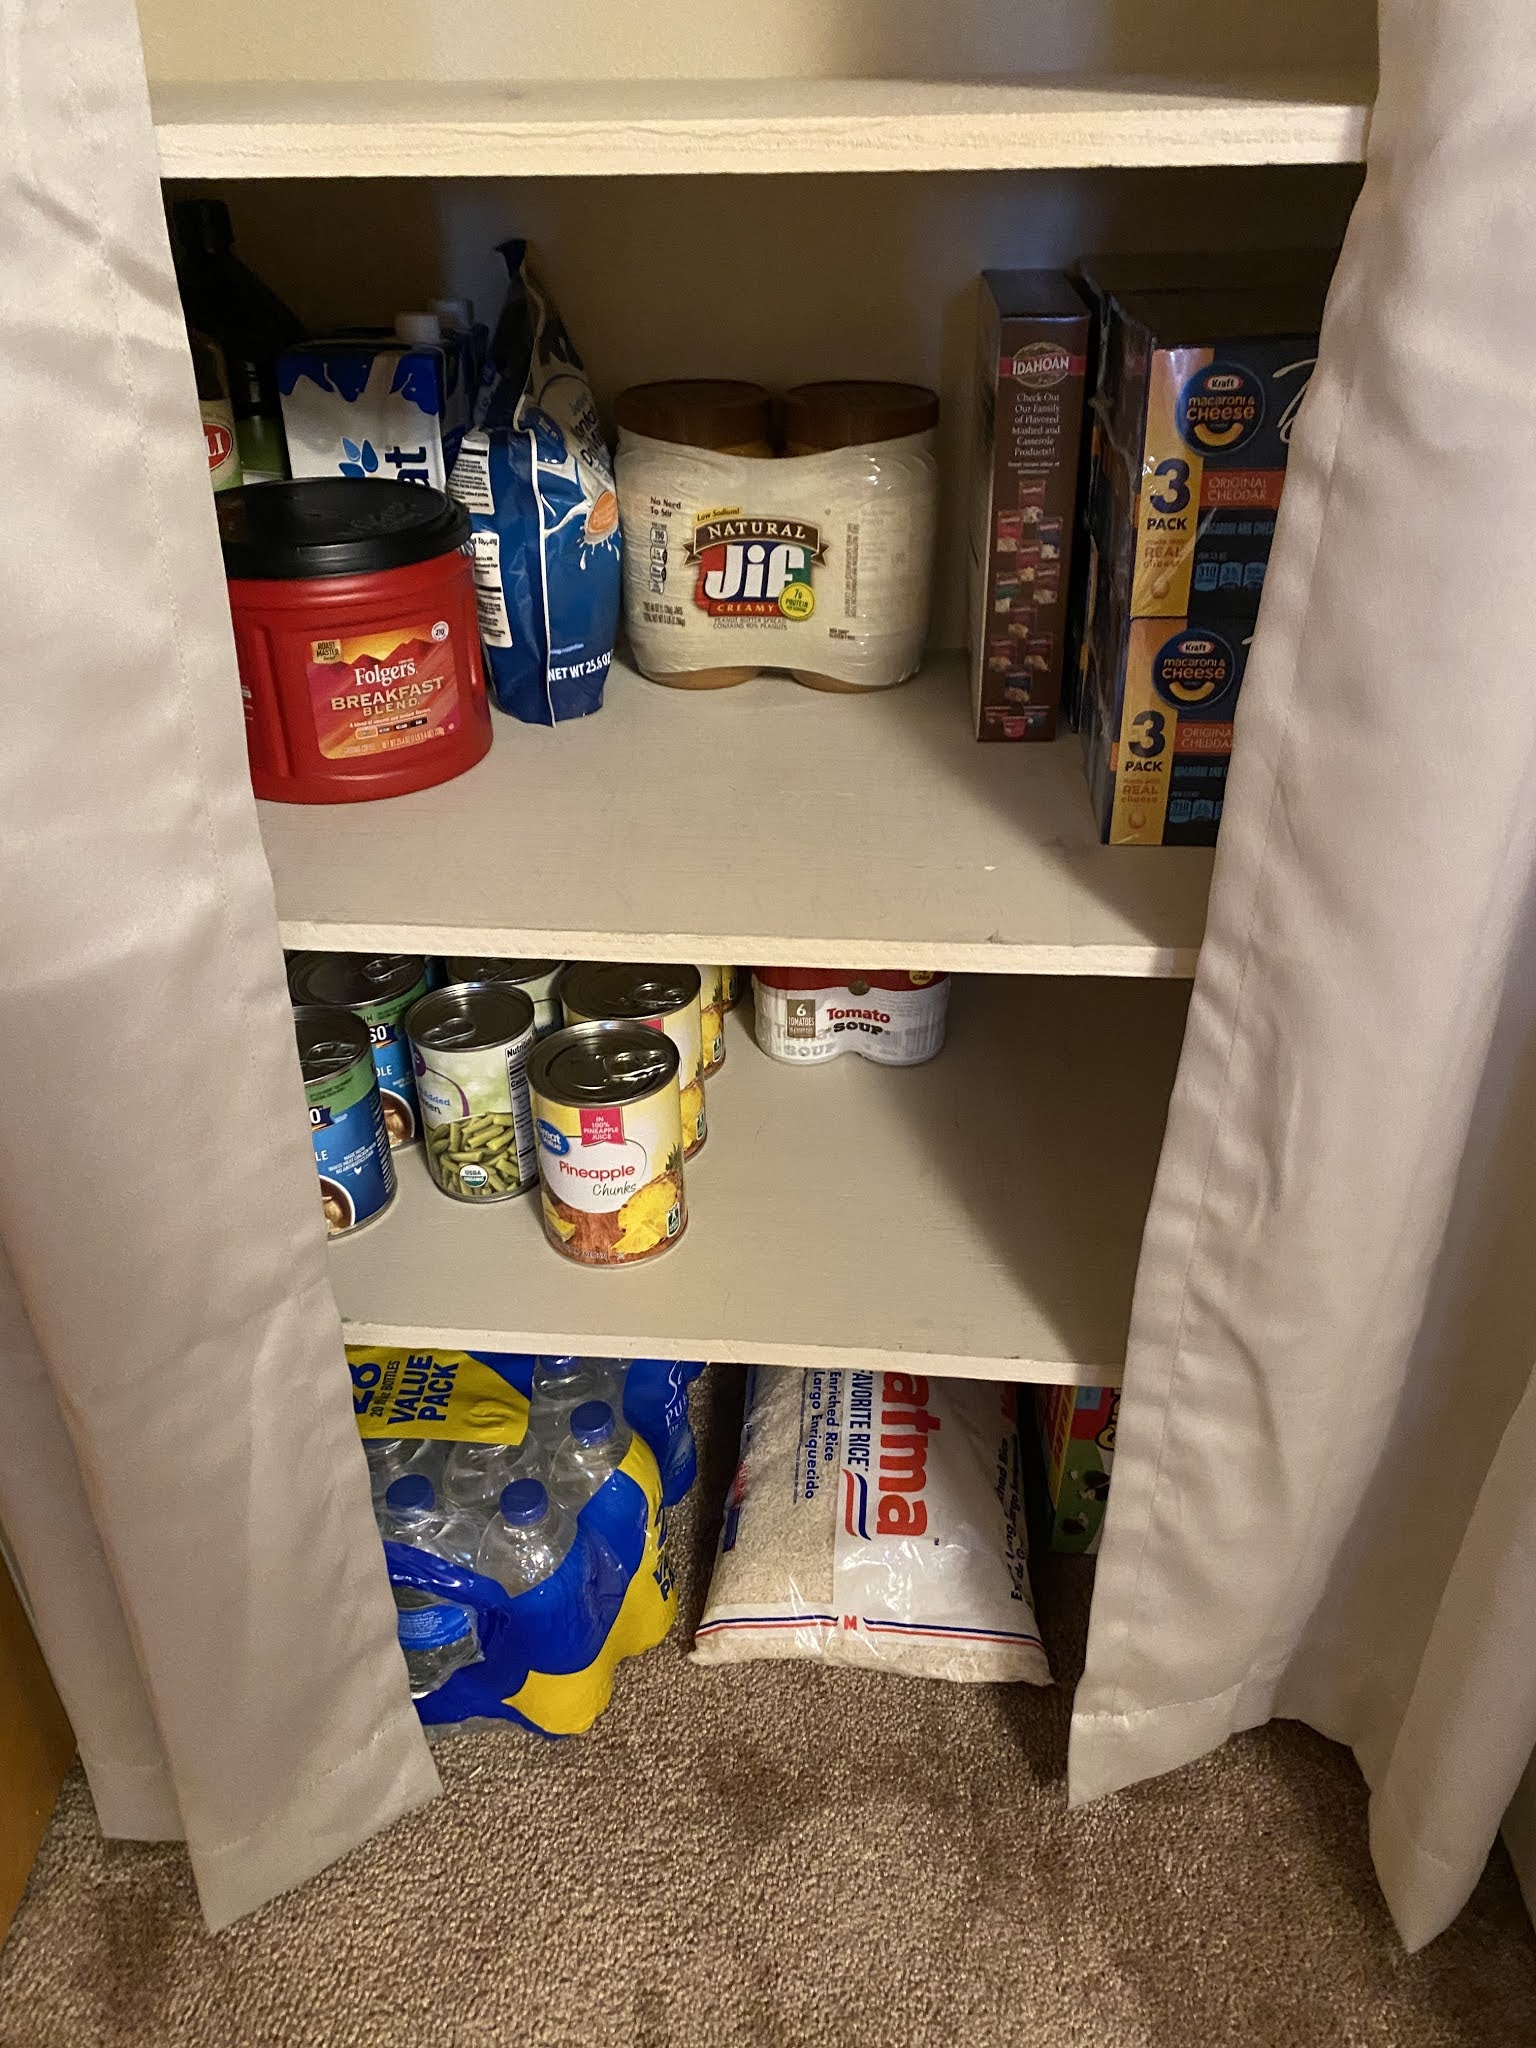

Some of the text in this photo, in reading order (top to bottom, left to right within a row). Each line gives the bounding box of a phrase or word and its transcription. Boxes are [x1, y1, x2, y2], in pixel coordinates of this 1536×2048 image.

[1012, 356, 1070, 376] IDAHOAN
[1211, 377, 1235, 388] Kraft
[1016, 392, 1060, 401] Check Out
[1188, 396, 1246, 406] macaroni
[1015, 404, 1060, 413] Our Family
[1015, 414, 1059, 423] of Flavored
[1012, 425, 1061, 435] Mashed and
[1016, 436, 1055, 445] Casserole
[1149, 457, 1191, 514] 3
[1208, 477, 1268, 488] ORIGINAL
[1207, 489, 1268, 501] CHEDDAR
[650, 496, 682, 509] No Need
[650, 506, 659, 515] To
[697, 512, 711, 522] Low
[1146, 517, 1188, 530] PACK
[707, 521, 807, 540] NATURAL
[704, 544, 805, 600] Jif
[716, 604, 776, 614] CREAMY
[317, 641, 336, 650] ROAST
[1185, 642, 1207, 652] Kraft
[316, 648, 340, 657] MASTER
[1163, 658, 1218, 668] macaroni
[354, 661, 418, 687] Folgers
[548, 667, 567, 682] NET
[569, 664, 584, 679] WT
[585, 658, 603, 675] 25.6
[331, 676, 445, 711] BREAKFAST
[362, 697, 420, 717] BLEND
[1129, 710, 1166, 758] 3
[1182, 728, 1233, 739] ORIGINA
[1125, 761, 1163, 772] PACK
[1122, 785, 1160, 795] REAL
[796, 1003, 807, 1017] 6
[826, 1007, 891, 1024] Tomato
[788, 1016, 815, 1026] TOMATOES
[559, 1160, 636, 1182] Pineapple
[592, 1181, 638, 1197] Chunks
[387, 1354, 434, 1424] VALUE
[417, 1362, 460, 1421] PACK
[849, 1369, 874, 1430] AVORITE
[824, 1370, 842, 1462] Enriched Rice
[804, 1371, 826, 1500] Largo Enriquecido
[843, 1614, 858, 1631] M
